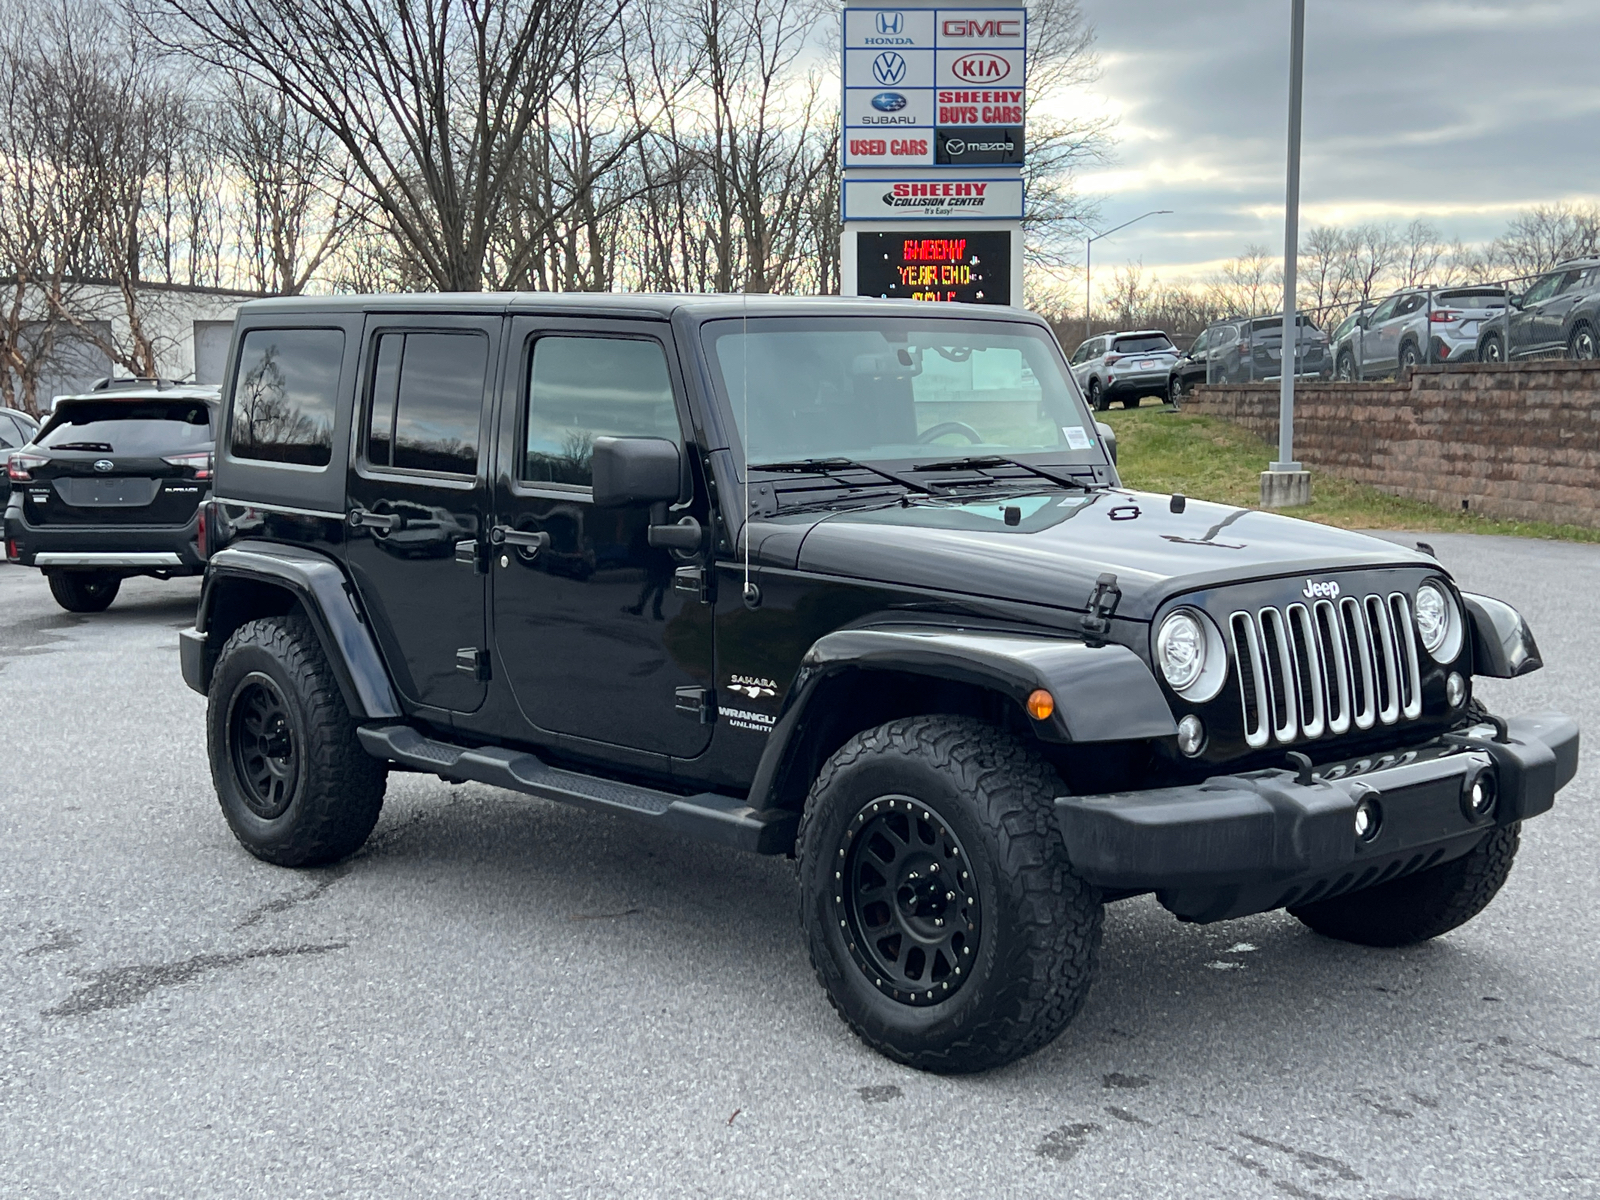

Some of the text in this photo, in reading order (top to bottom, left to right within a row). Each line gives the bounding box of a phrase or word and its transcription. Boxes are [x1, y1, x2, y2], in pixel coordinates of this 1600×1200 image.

[942, 20, 1021, 37] GMC
[962, 60, 1001, 77] KIA
[939, 92, 1022, 103] SHEEHY
[862, 116, 916, 125] SUBARU
[939, 106, 1022, 124] BUYS CARS
[850, 139, 928, 156] USED CARS
[967, 142, 1014, 151] mazda
[893, 183, 988, 197] SHEEHY
[893, 197, 986, 207] COLLISION CENTER
[924, 207, 953, 215] It's Easy!
[903, 239, 966, 260] SHEEHY
[897, 265, 970, 285] YEAR END
[1302, 579, 1340, 599] Jeep
[731, 674, 778, 689] SAHARA
[718, 706, 777, 725] WRANGL
